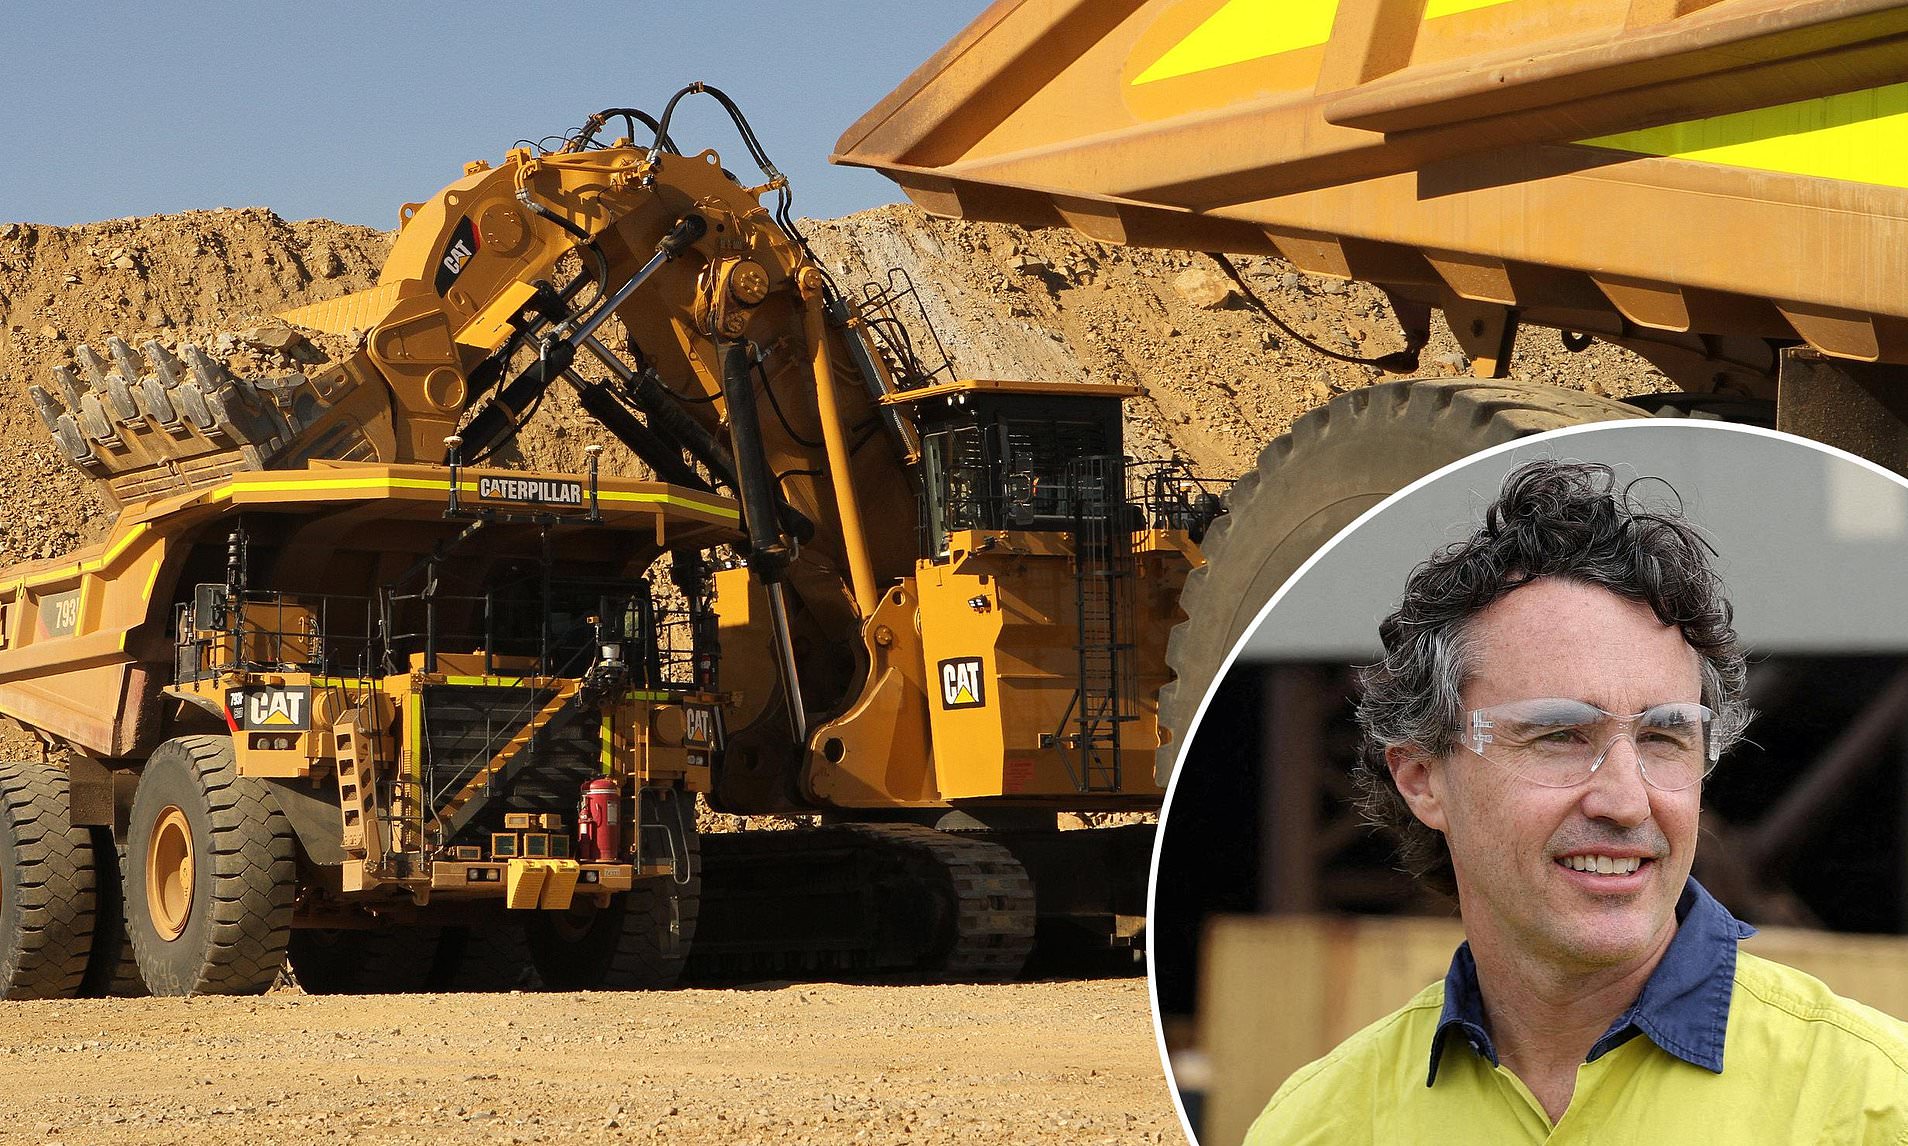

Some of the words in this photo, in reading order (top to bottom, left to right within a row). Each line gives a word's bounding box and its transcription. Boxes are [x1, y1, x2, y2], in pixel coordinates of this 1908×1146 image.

[443, 239, 473, 274] CAT
[480, 478, 582, 503] CATERPILLAR
[942, 662, 980, 705] CAT
[250, 691, 304, 725] CAT
[686, 708, 709, 742] CAT
